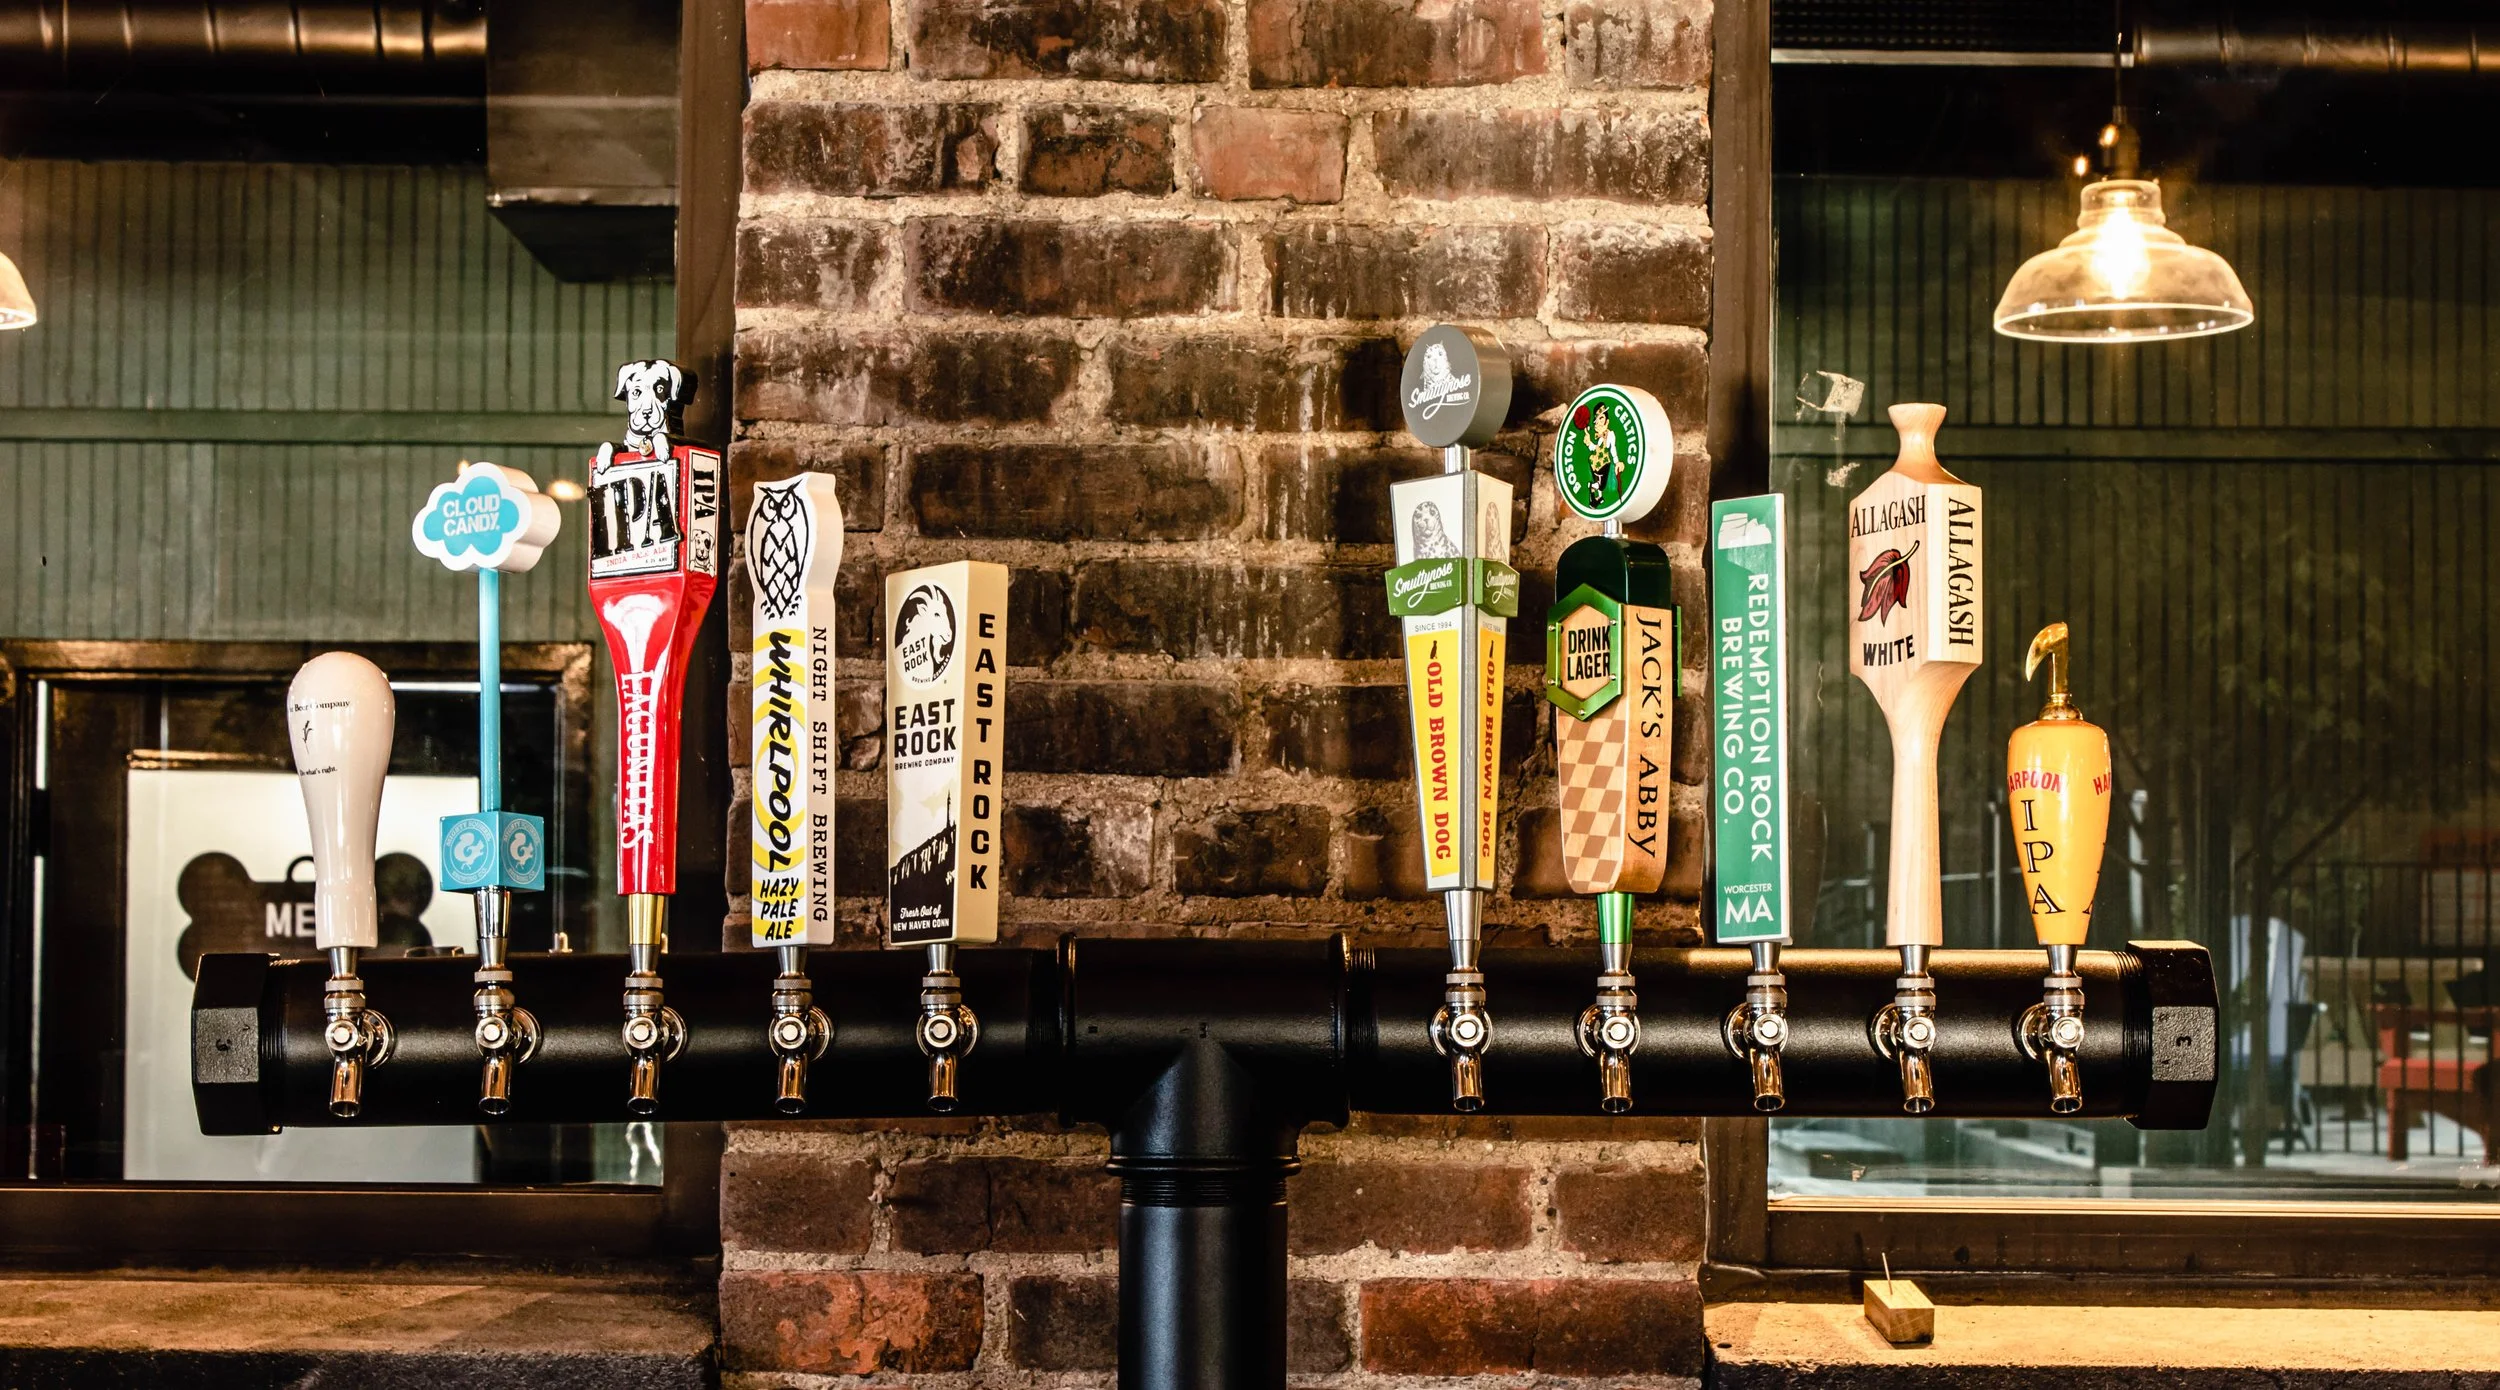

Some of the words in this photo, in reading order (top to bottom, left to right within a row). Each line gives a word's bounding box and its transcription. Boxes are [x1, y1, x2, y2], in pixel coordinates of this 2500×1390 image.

[1408, 373, 1471, 420] Smuttynose
[1614, 405, 1637, 465] CELTICS
[1564, 431, 1582, 494] BOSTON
[443, 493, 500, 518] CLOUD
[587, 471, 683, 560] IPA
[693, 469, 717, 520] IPA
[1850, 494, 1926, 538] ALLAGASH
[1392, 561, 1454, 608] Smuttynose
[1948, 498, 1976, 647] ALLAGASH
[902, 636, 926, 659] EAST
[1414, 622, 1436, 632] SINCE
[1437, 621, 1452, 629] 1994
[1568, 625, 1610, 654] DRINK
[1863, 634, 1915, 666] WHITE
[813, 626, 827, 701] NIGHT
[904, 651, 928, 672] ROCK
[975, 612, 996, 744] EAST
[1427, 661, 1444, 708] OLD
[1486, 660, 1496, 707] OLD
[1567, 652, 1610, 681] LAGER
[1636, 613, 1665, 738] JACK'S
[1748, 573, 1771, 764] REDEMPTION
[1721, 617, 1744, 759] BREWING
[894, 698, 956, 731] EAST
[621, 669, 655, 849] LAGUNITAS
[769, 631, 791, 872] WHIRLPOOL
[813, 722, 827, 794] SHIFT
[894, 726, 957, 759] ROCK
[895, 760, 922, 770] BREWING
[925, 756, 954, 766] COMPANY
[1429, 716, 1449, 802] BROWN
[1483, 714, 1494, 800] BROWN
[1723, 767, 1745, 824] CO.
[2008, 770, 2061, 793] ARPOON
[970, 759, 992, 890] ROCK
[1628, 755, 1660, 859] ABBY
[1750, 774, 1773, 863] ROCK
[1434, 812, 1452, 860] DOG
[1482, 811, 1492, 858] DOG
[2020, 799, 2066, 914] IPA
[759, 877, 799, 899] HAZY
[813, 814, 828, 922] BREWING
[1724, 883, 1772, 895] WORCESTER
[265, 902, 316, 938] ME
[760, 898, 798, 920] PALE
[765, 919, 794, 941] ALE
[893, 921, 907, 931] NEW
[909, 920, 931, 930] HAVEN
[932, 918, 950, 928] CONN
[900, 907, 920, 919] Fresh
[920, 905, 933, 917] Out
[933, 904, 942, 918] of
[1725, 894, 1774, 924] MA
